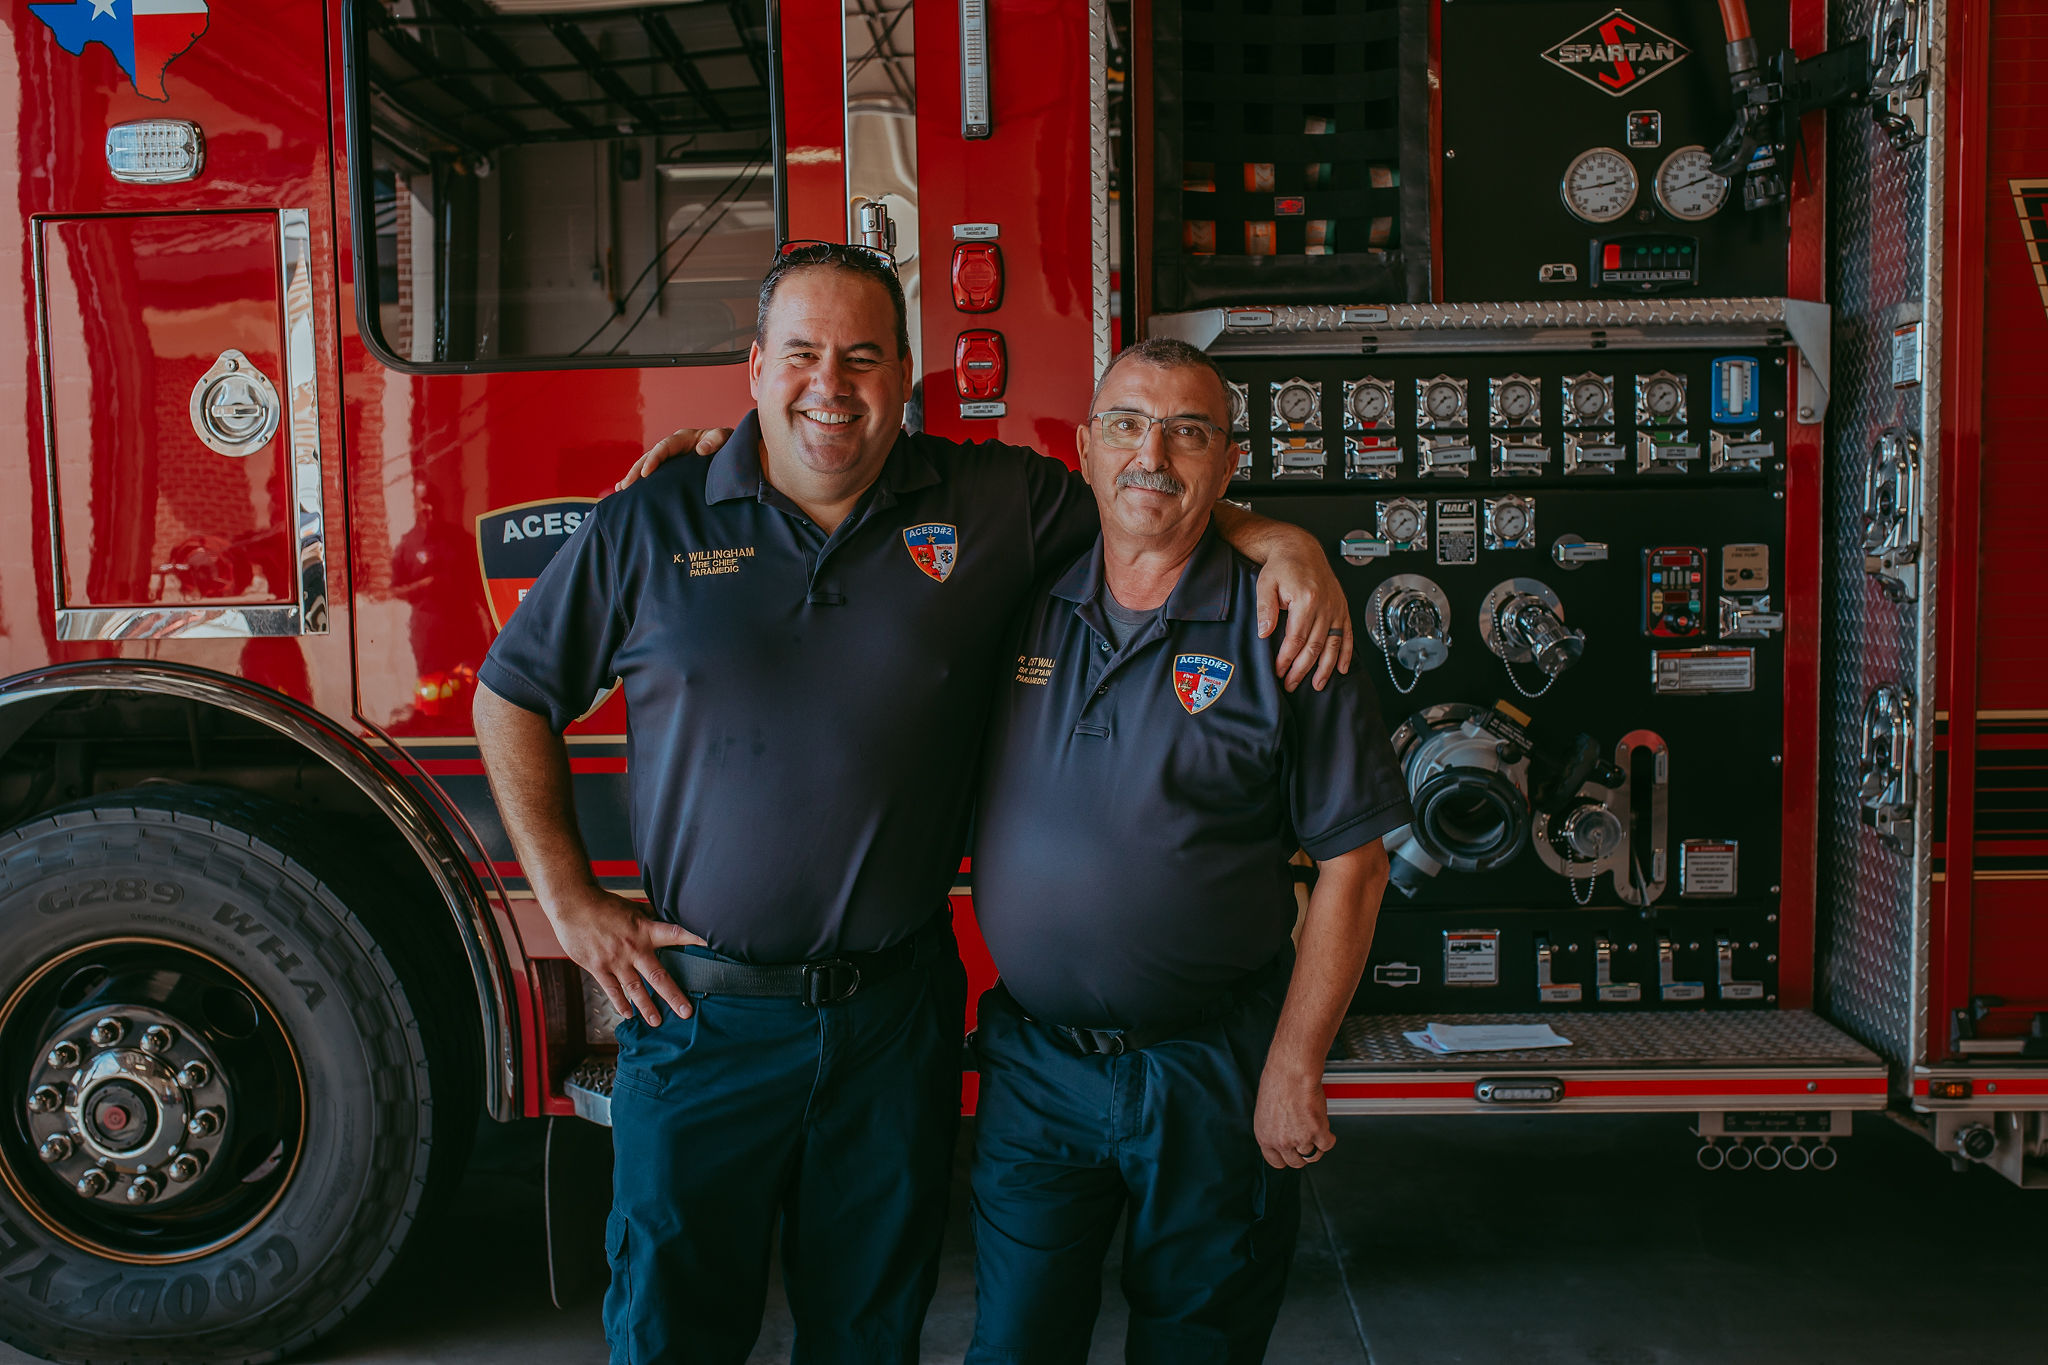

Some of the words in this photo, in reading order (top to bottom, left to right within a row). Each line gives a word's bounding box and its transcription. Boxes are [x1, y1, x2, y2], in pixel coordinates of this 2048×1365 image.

[1558, 42, 1675, 62] SPARTAN
[1443, 504, 1469, 512] HALE
[502, 511, 590, 544] ACES
[910, 526, 952, 538] ACESD#2
[673, 554, 684, 564] K.
[688, 546, 755, 562] WILLINGHAM
[690, 566, 739, 577] PARAMEDIC
[691, 560, 710, 569] FIRE
[712, 558, 738, 567] CHIEF
[1180, 656, 1228, 671] ACESD#2
[38, 878, 184, 914] G289
[212, 902, 328, 1012] WHA
